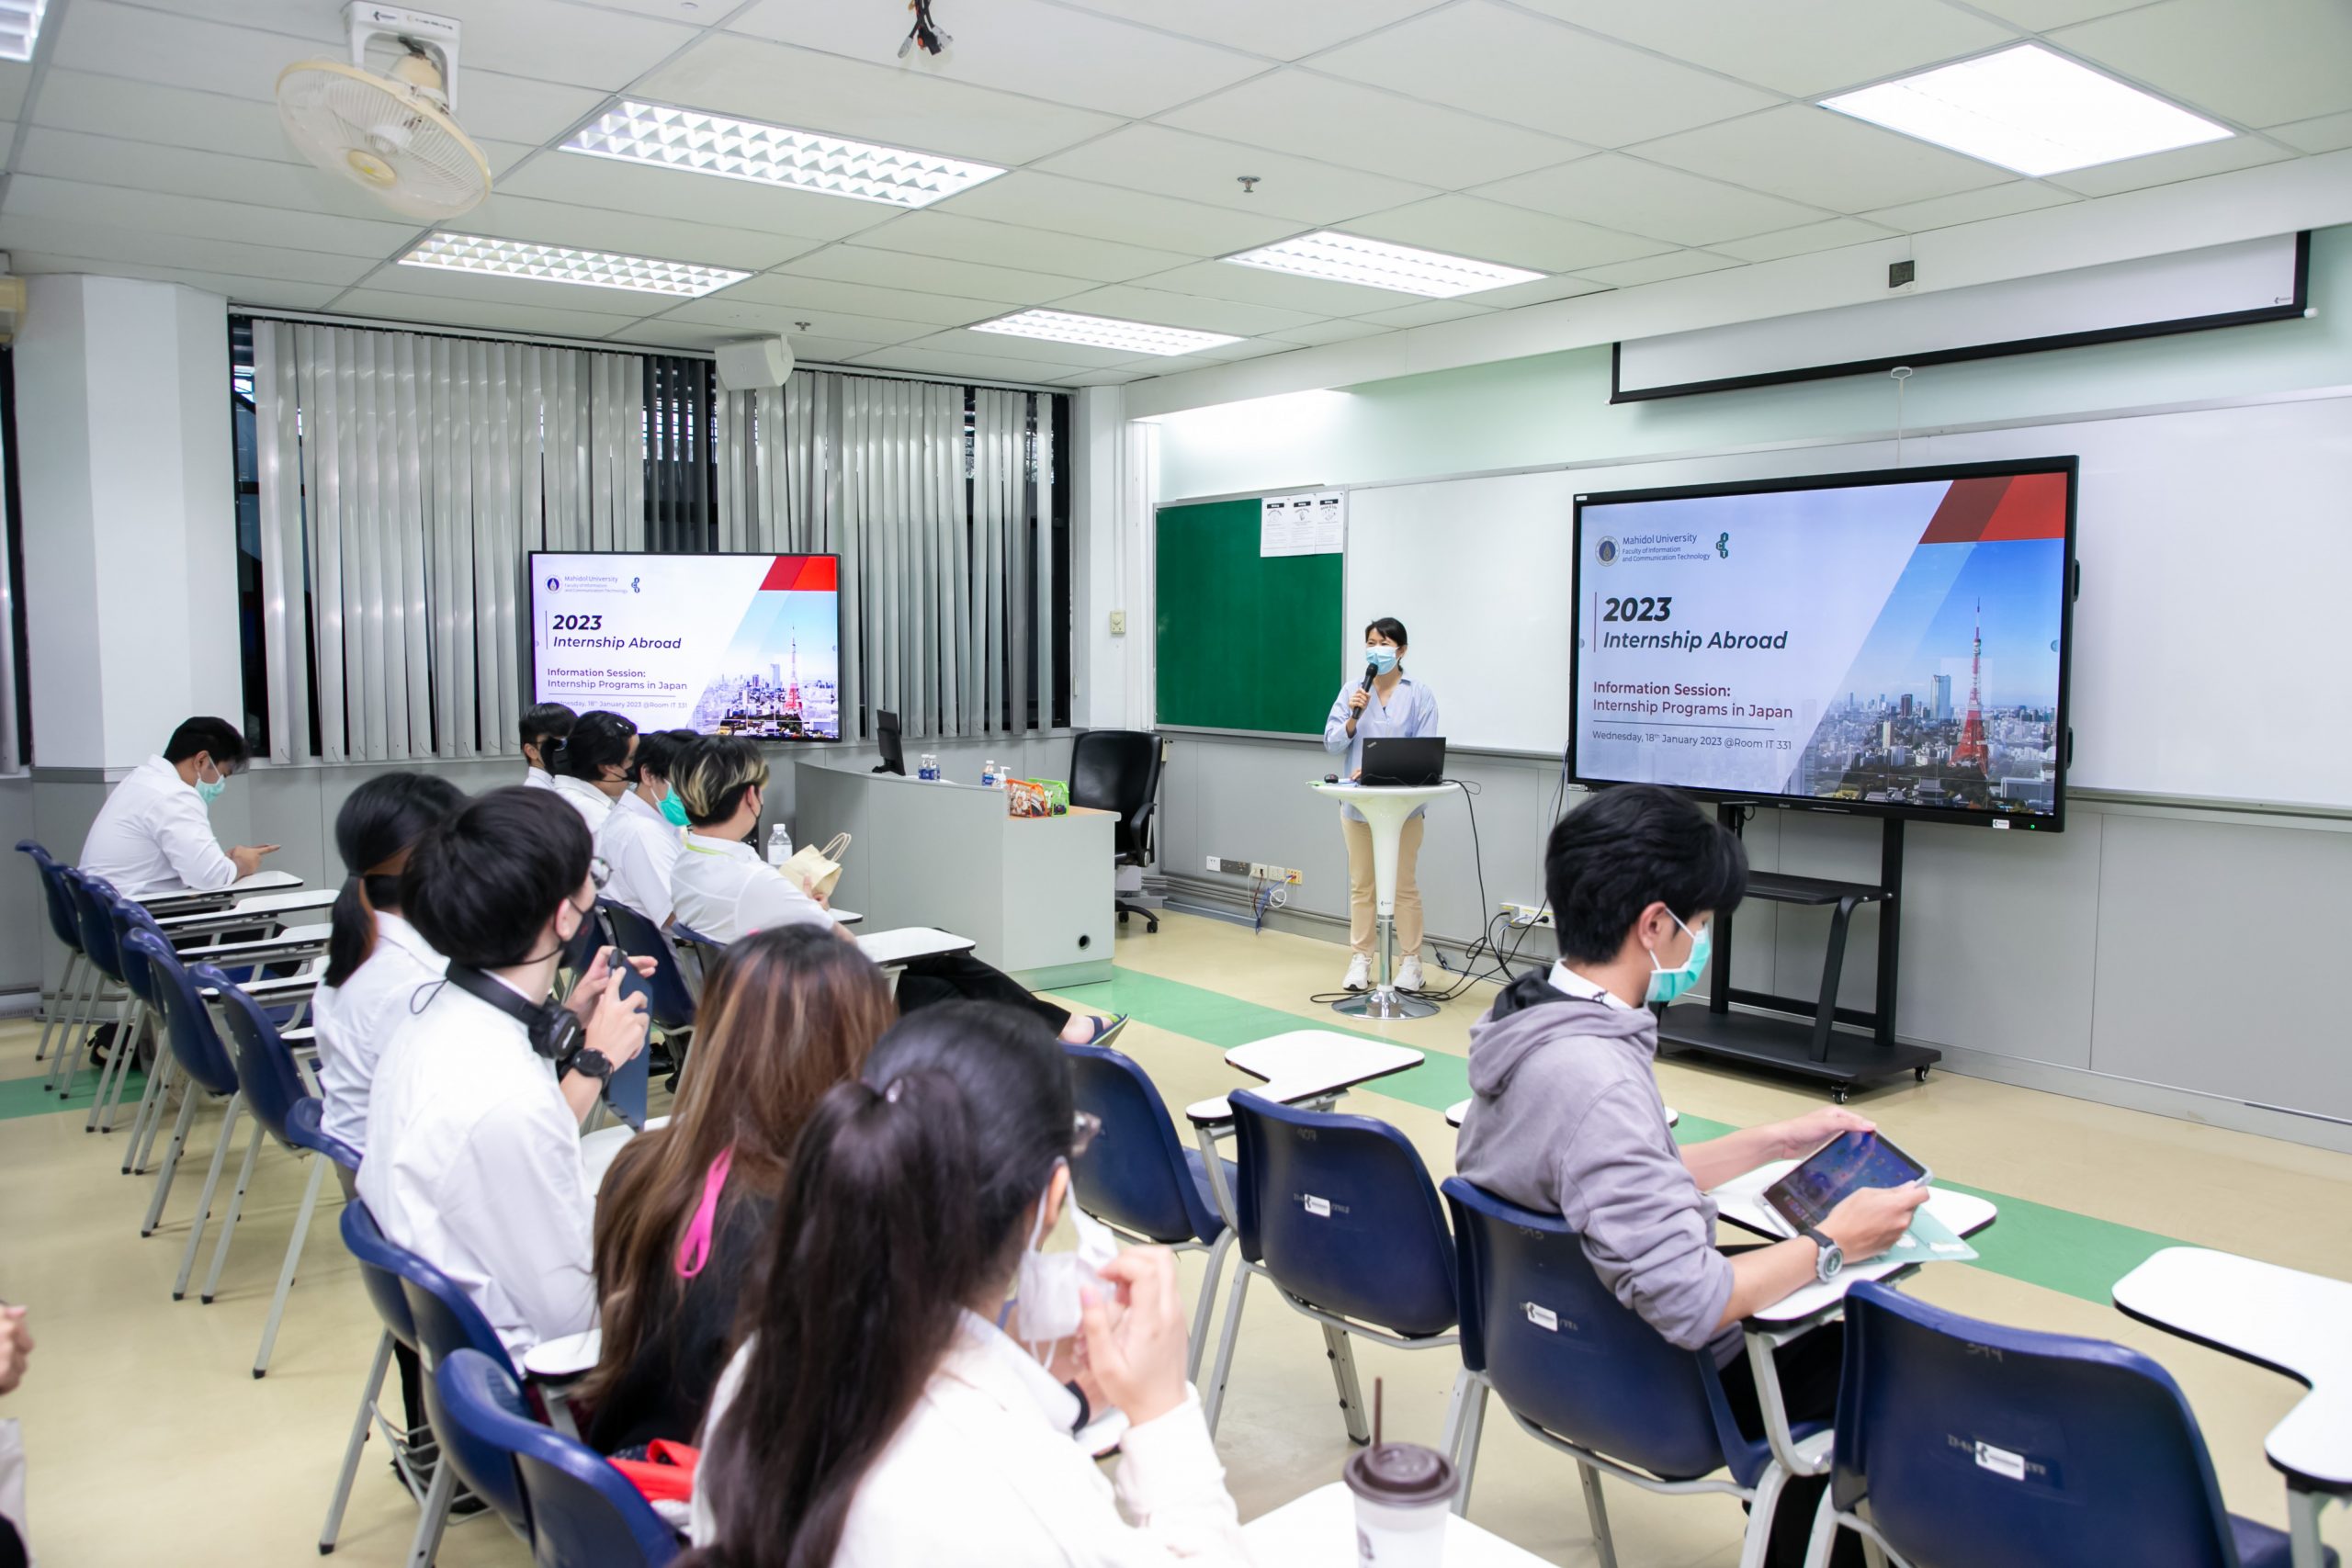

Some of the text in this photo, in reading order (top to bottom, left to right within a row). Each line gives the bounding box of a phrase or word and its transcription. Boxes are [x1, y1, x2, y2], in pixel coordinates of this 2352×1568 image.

[1623, 533, 1698, 545] Mahidol University
[1678, 553, 1711, 561] Technology
[1602, 597, 1672, 622] 2023
[552, 615, 603, 631] 2023
[553, 636, 682, 650] Internship Abroad
[1602, 630, 1789, 653] Internship Abroad
[548, 668, 646, 678] Information Session:
[548, 680, 596, 690] Internship
[599, 681, 644, 691] Programs
[658, 682, 687, 691] Japan
[1593, 682, 1731, 697] Information Session:
[1593, 699, 1792, 720] Internship Programs in Japan
[1592, 730, 1644, 743] Wednesday,
[1662, 734, 1698, 747] January
[1700, 736, 1722, 746] 2023
[1724, 738, 1763, 749] @Room
[1765, 739, 1774, 749] IT
[1777, 740, 1792, 750] 331
